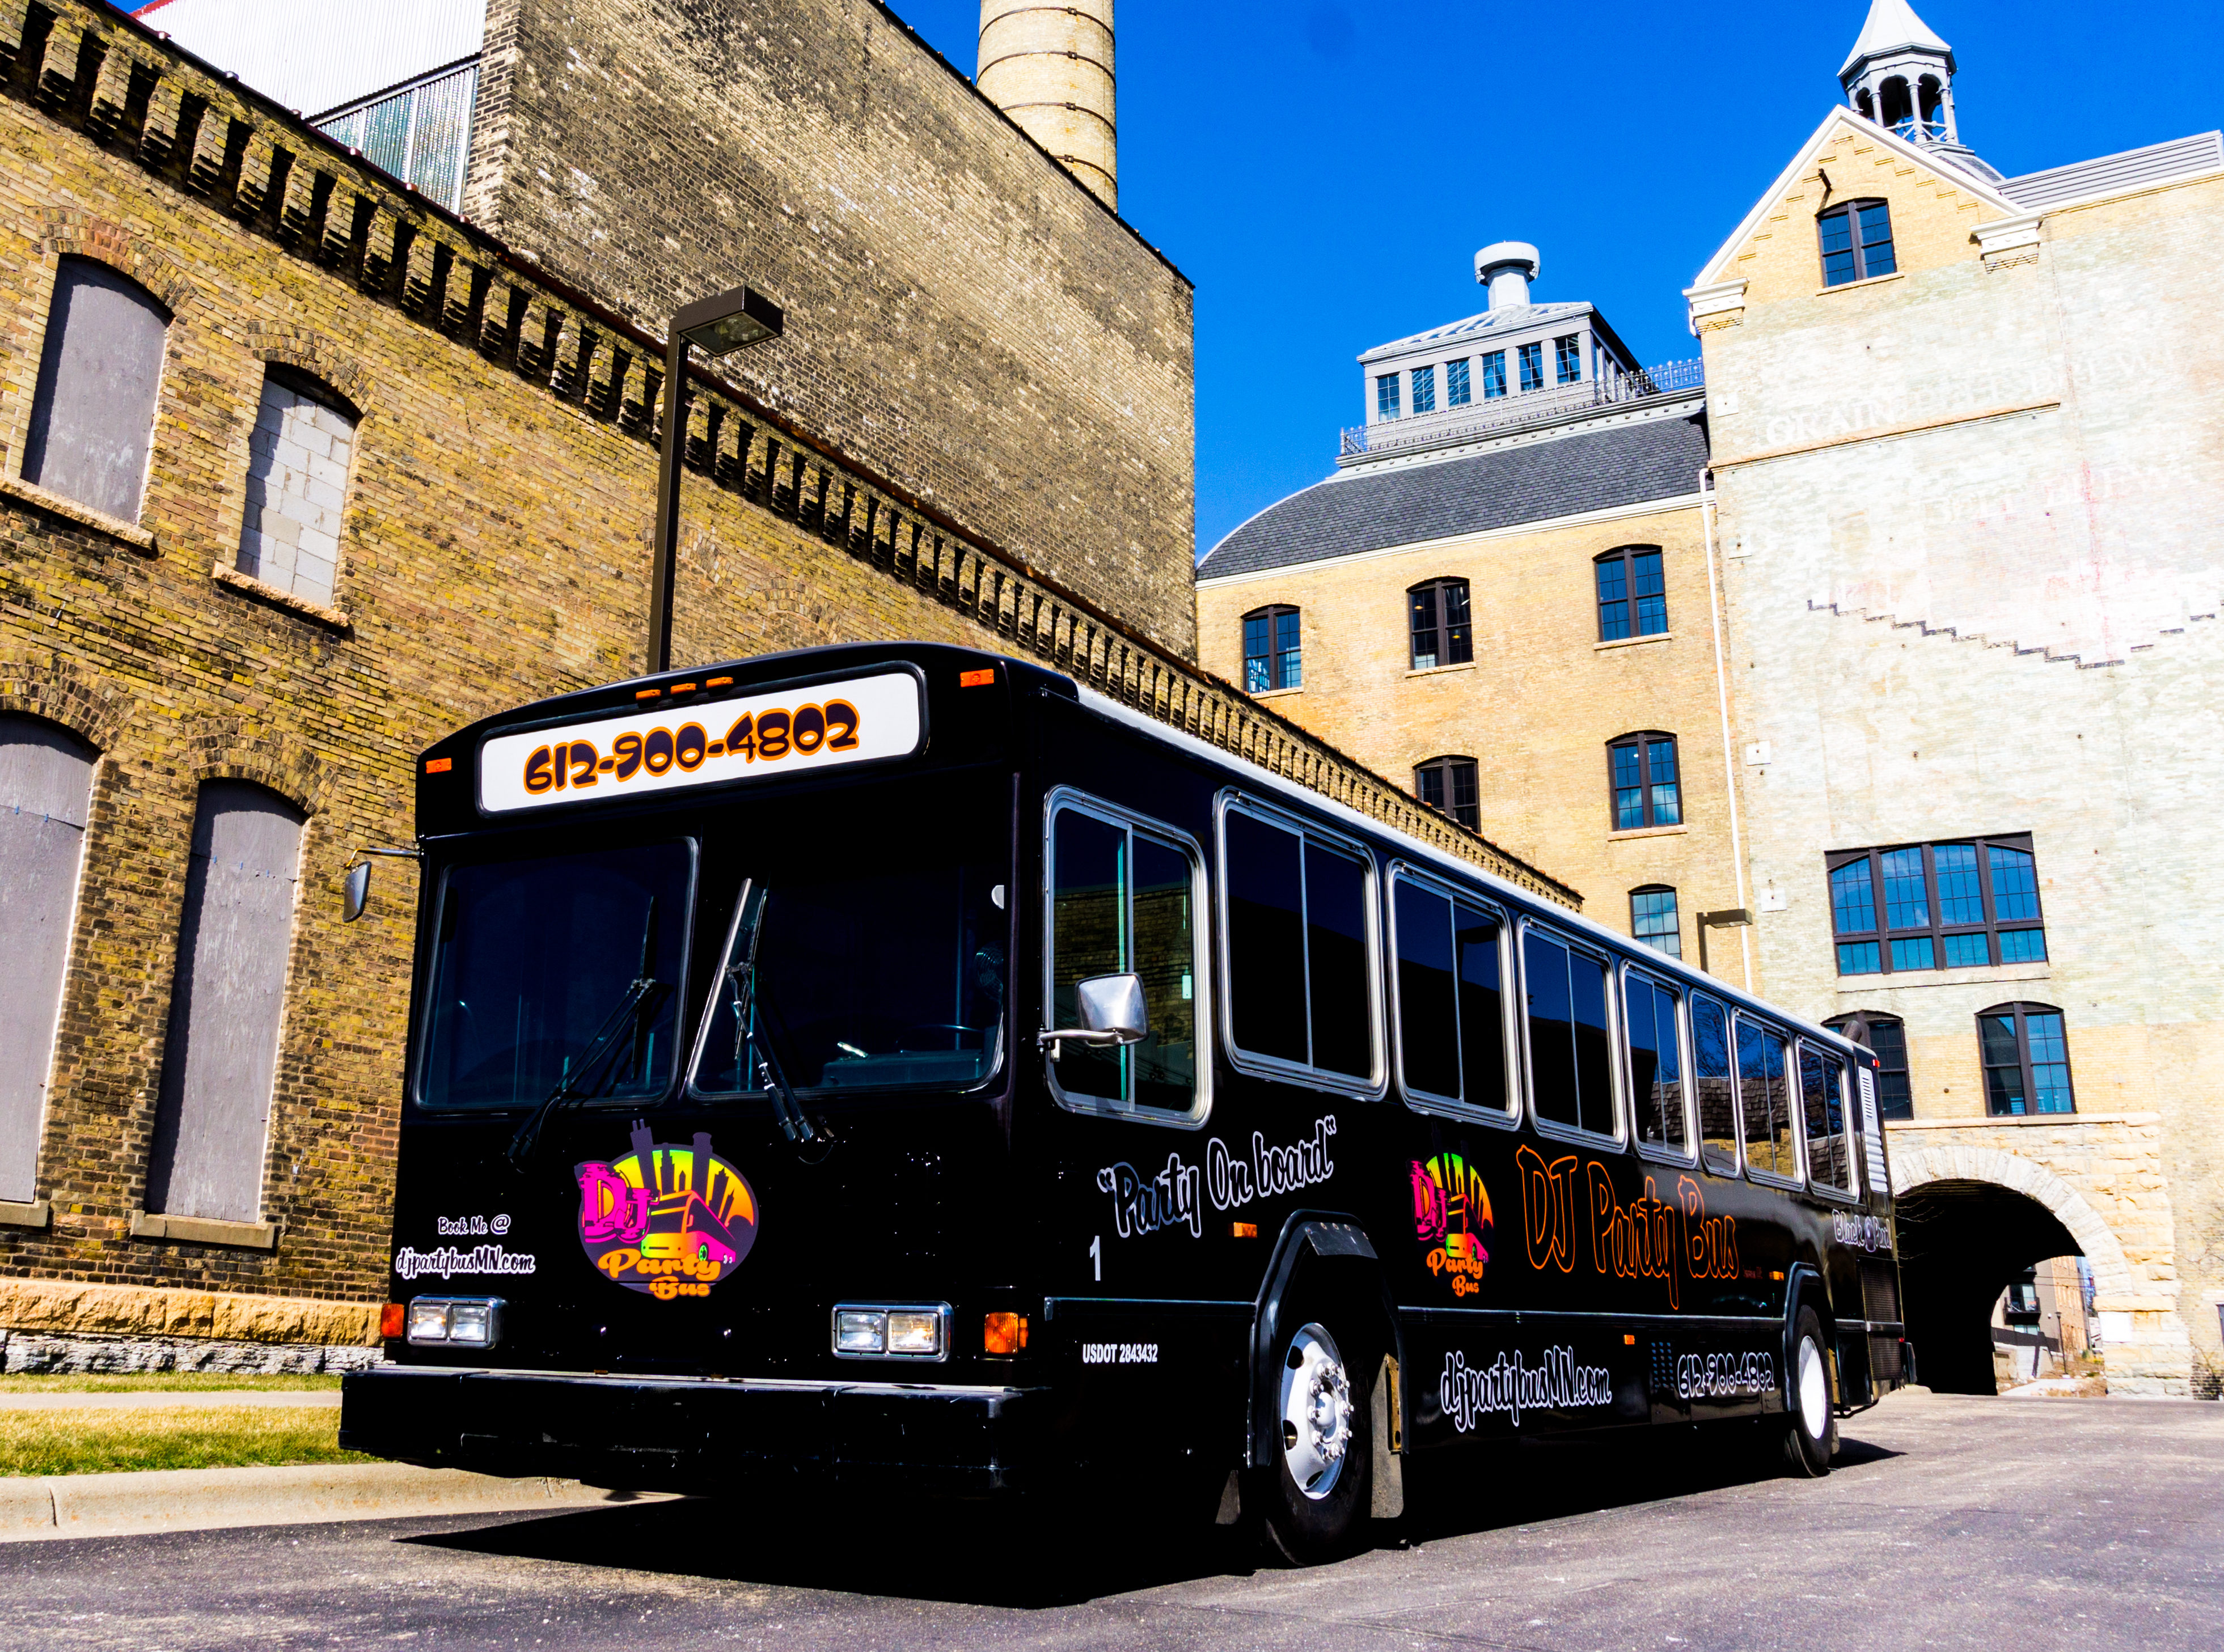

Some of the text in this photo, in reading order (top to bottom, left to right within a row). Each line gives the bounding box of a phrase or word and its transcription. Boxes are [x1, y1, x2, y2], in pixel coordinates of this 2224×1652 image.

[524, 698, 861, 795] 612-900-4802
[1207, 1137, 1253, 1210] On
[578, 1163, 660, 1243] DJ
[1410, 1160, 1449, 1242] DJ
[438, 1214, 511, 1235] Book Me @
[1516, 1144, 1739, 1310] DJ Party Bus
[395, 1244, 536, 1280] djpartybusMN.com
[598, 1248, 721, 1281] Party
[1089, 1235, 1101, 1281] 1
[1426, 1247, 1483, 1280] Party
[649, 1276, 711, 1301] Bus
[1452, 1274, 1479, 1297] Bus
[1083, 1344, 1158, 1363] USDOT 2843432
[1677, 1351, 1775, 1399] 612-900-4802
[1440, 1345, 1612, 1433] djpartybusMN.com
